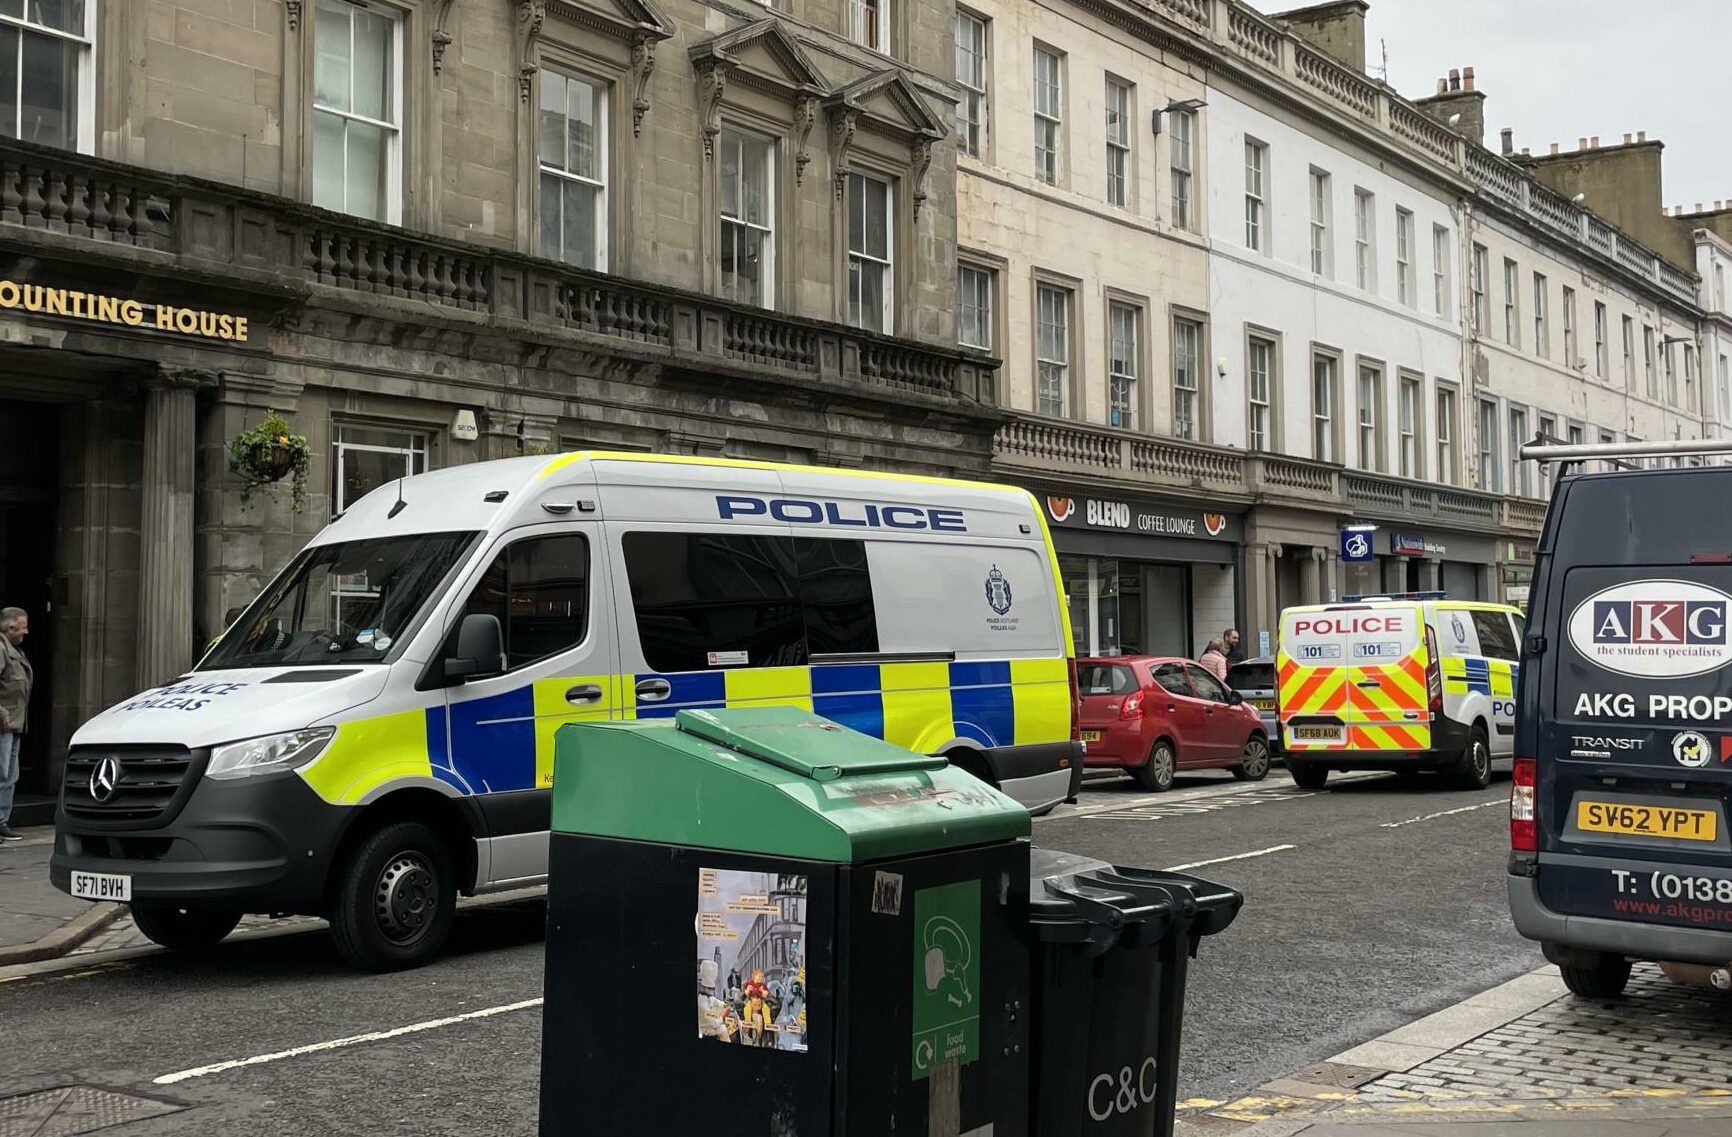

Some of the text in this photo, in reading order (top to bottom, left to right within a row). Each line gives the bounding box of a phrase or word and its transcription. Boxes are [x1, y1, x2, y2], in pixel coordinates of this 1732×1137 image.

[0, 280, 248, 341] OUNTING HOUSE
[715, 495, 967, 532] POLICE
[1087, 500, 1195, 534] BLEND COFFEE LOUNGE
[1295, 617, 1403, 635] POLICE
[1596, 604, 1724, 642] AKG
[1305, 646, 1322, 657] 101
[1362, 644, 1381, 655] 101
[1597, 645, 1722, 658] the student specialists
[1574, 693, 1732, 720] AKG PROP
[1299, 728, 1321, 738] SF68
[1571, 736, 1645, 750] TRANSIT
[1588, 805, 1705, 835] SV62 YPT
[76, 875, 123, 897] SF71 BVH
[1611, 869, 1732, 903] T: (0138
[946, 1028, 964, 1046] food
[944, 1045, 967, 1059] waste
[1088, 1056, 1157, 1121] C&C
